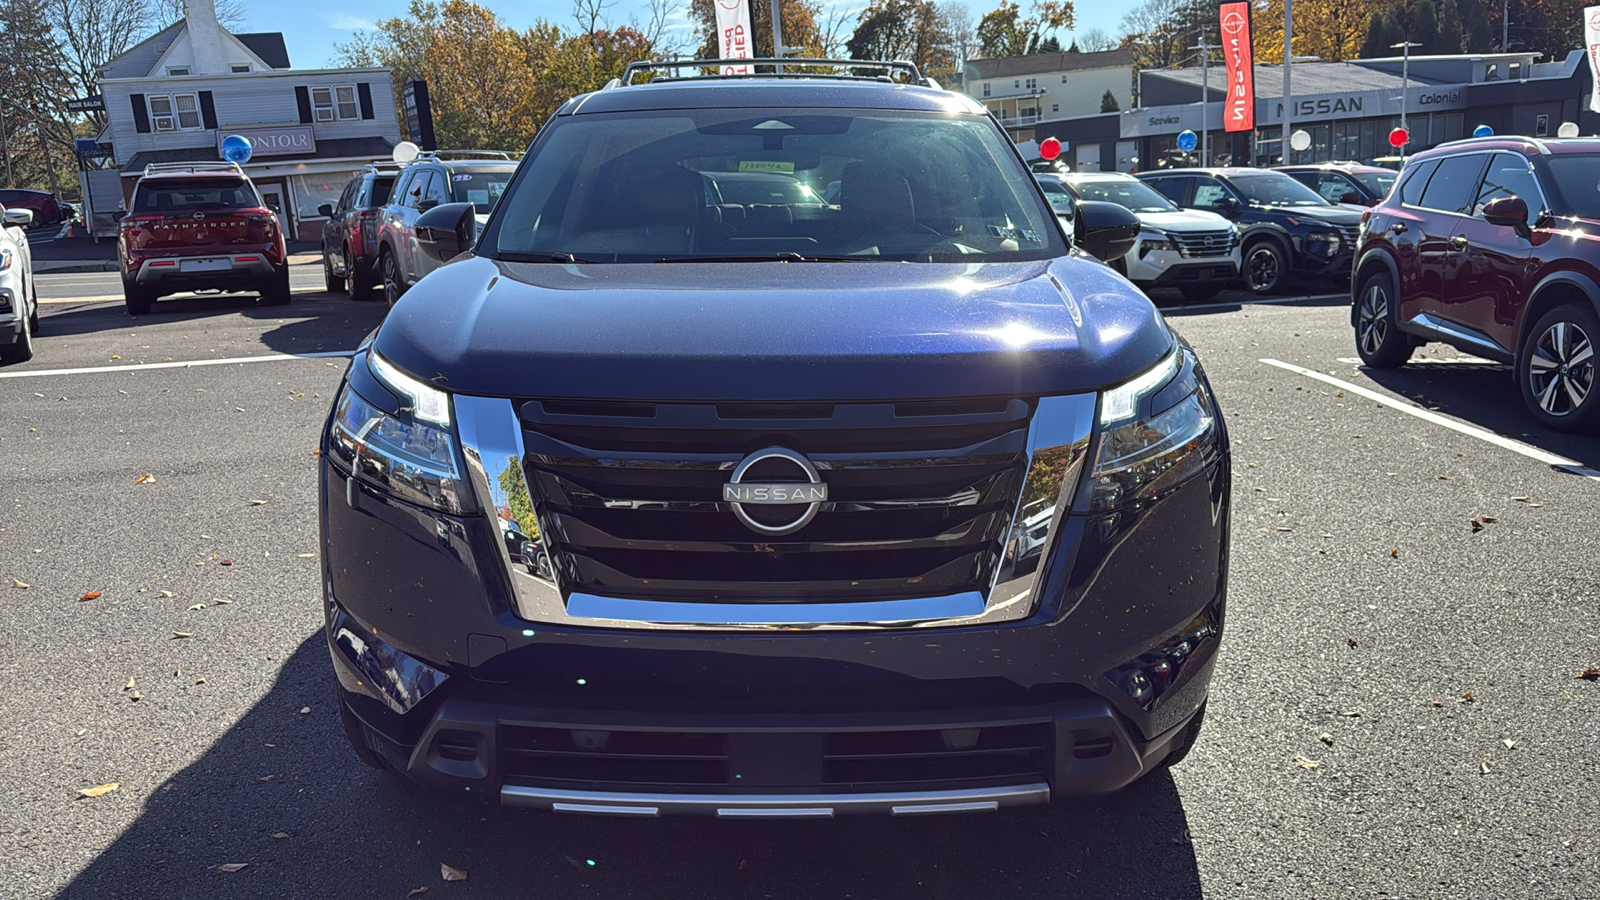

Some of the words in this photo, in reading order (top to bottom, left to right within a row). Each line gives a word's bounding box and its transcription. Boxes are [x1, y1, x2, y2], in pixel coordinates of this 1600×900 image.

[1419, 91, 1461, 105] Colonial
[1276, 96, 1363, 118] NISSAN
[1149, 115, 1180, 126] Service
[247, 133, 308, 149] ONTOUR
[153, 221, 247, 230] PATHFINDER
[726, 486, 825, 500] NISSAN
